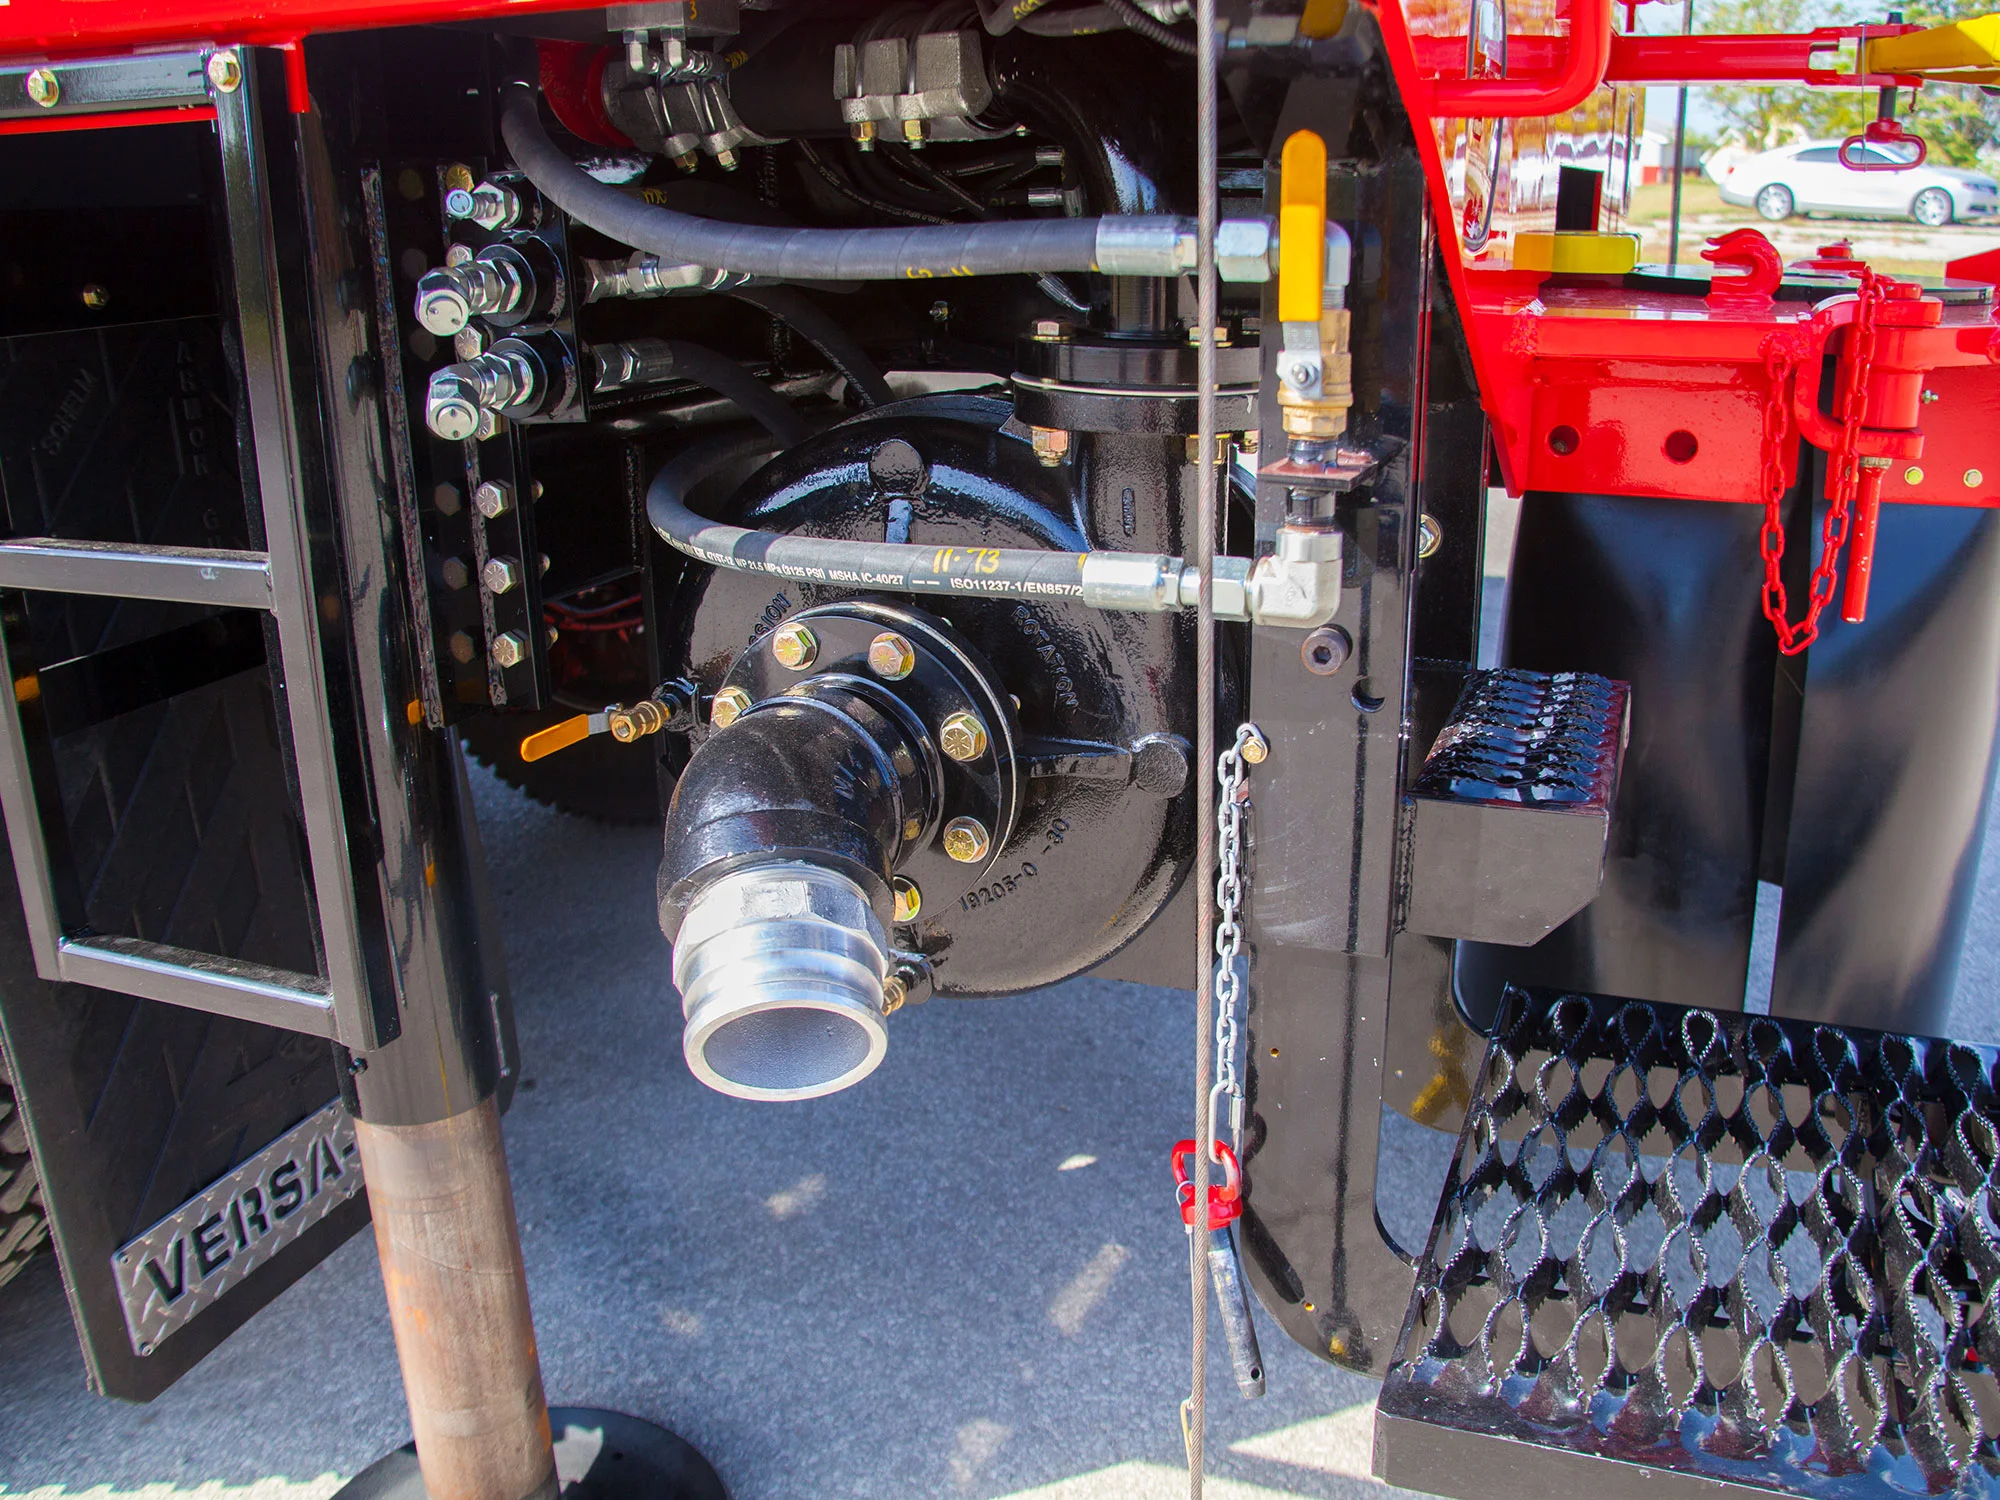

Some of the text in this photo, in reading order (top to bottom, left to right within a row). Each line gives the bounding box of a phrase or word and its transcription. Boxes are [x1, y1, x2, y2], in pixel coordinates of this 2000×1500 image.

[735, 557, 748, 570] WP
[748, 559, 764, 572] 21.5
[764, 561, 781, 574] MPa
[781, 563, 806, 578] (3125
[806, 567, 826, 581] PSI)
[829, 570, 861, 583] MSHA
[862, 572, 904, 586] IC-40/27
